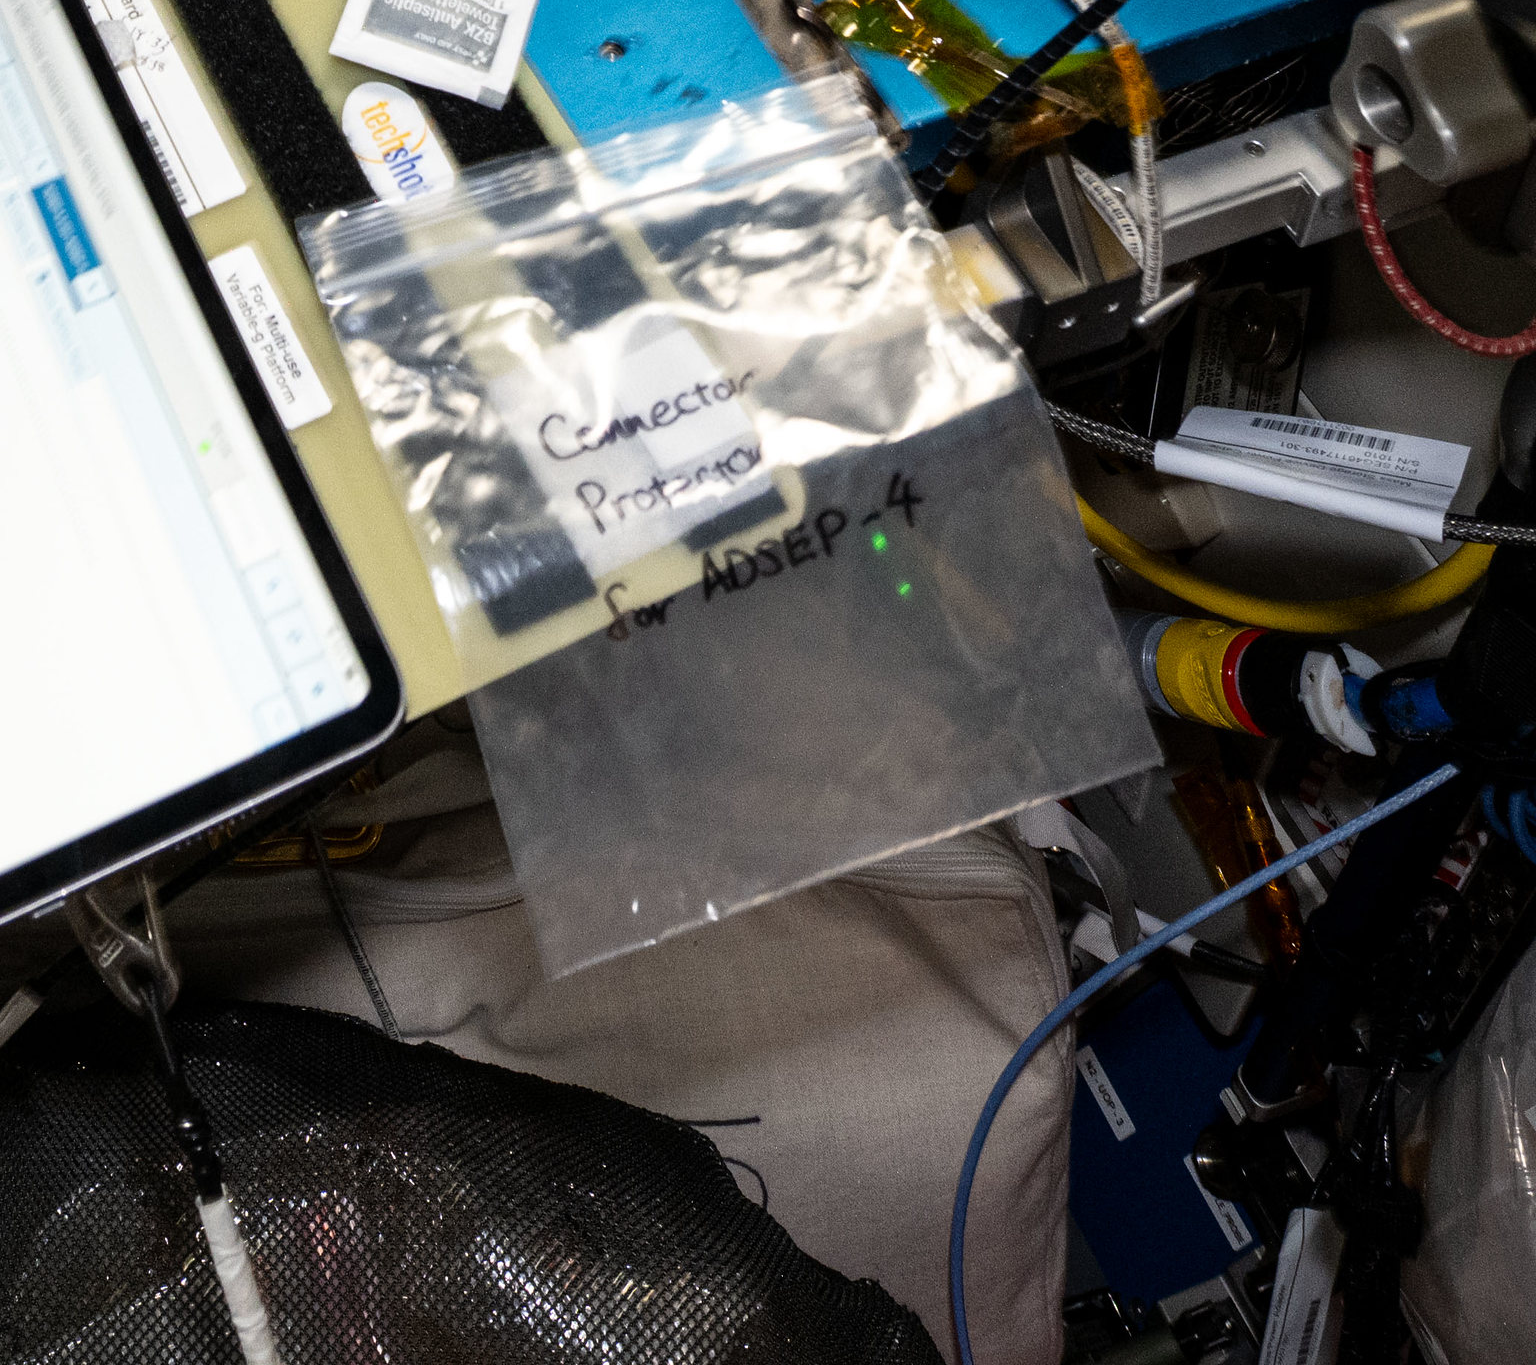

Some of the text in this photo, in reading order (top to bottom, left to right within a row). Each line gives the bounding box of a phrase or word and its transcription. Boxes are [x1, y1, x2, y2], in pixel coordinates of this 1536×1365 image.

[462, 23, 496, 46] BZK
[226, 272, 296, 405] Variable-g Platform
[265, 314, 302, 380] Multi-use
[1394, 463, 1419, 476] P/N
[1396, 456, 1422, 468] S/N
[603, 472, 923, 641] for ADSEP-4
